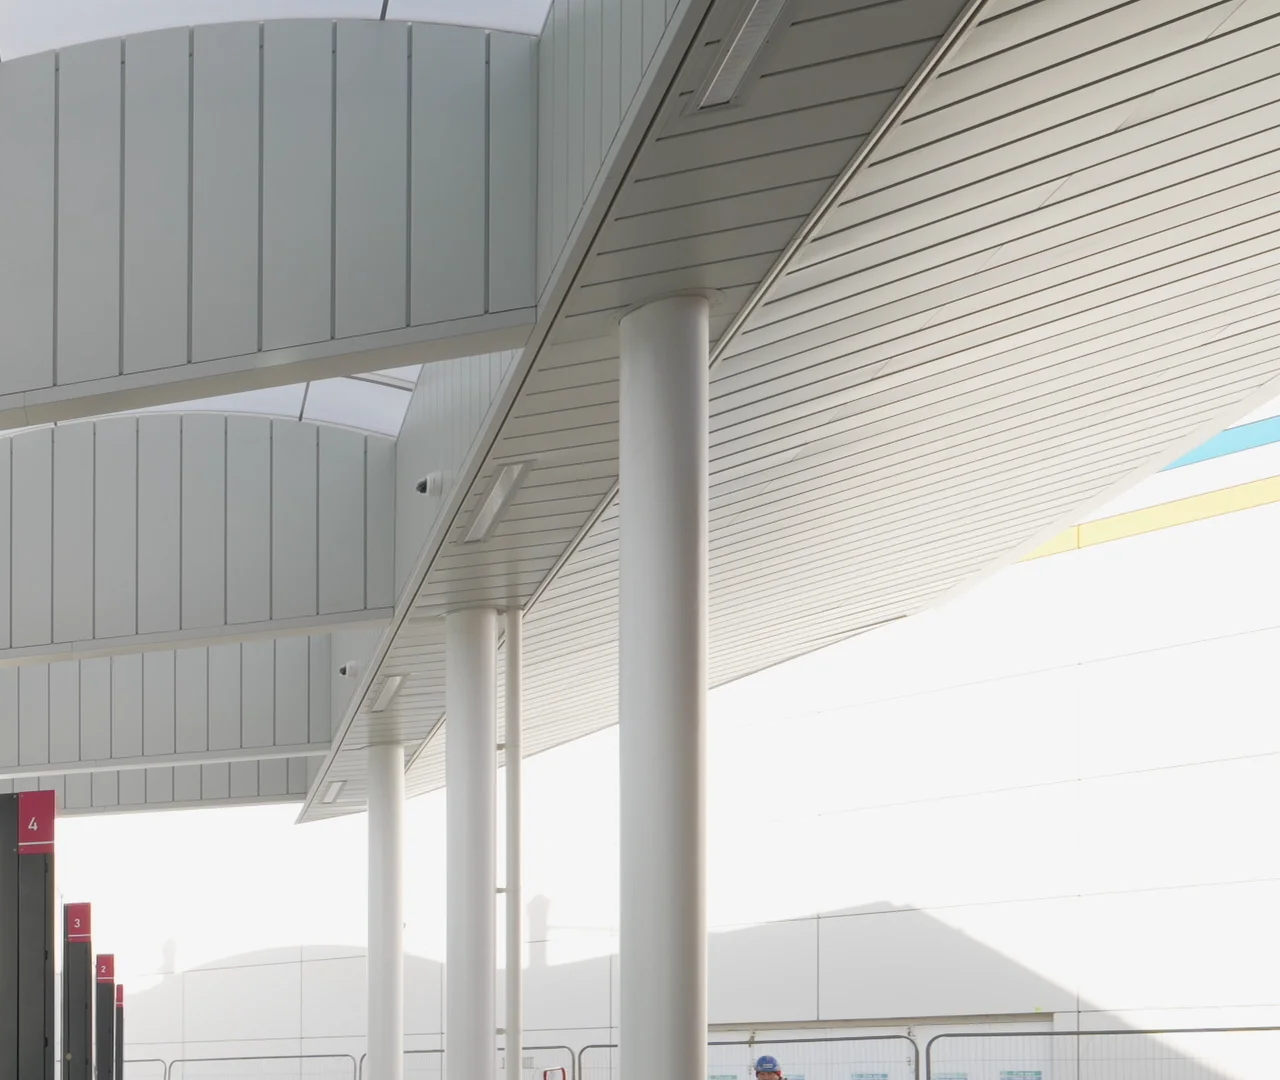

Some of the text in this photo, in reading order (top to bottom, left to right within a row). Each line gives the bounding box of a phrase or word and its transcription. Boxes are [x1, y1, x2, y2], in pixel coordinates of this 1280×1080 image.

[27, 816, 38, 831] 4
[73, 918, 81, 928] 3
[100, 965, 107, 973] 2
